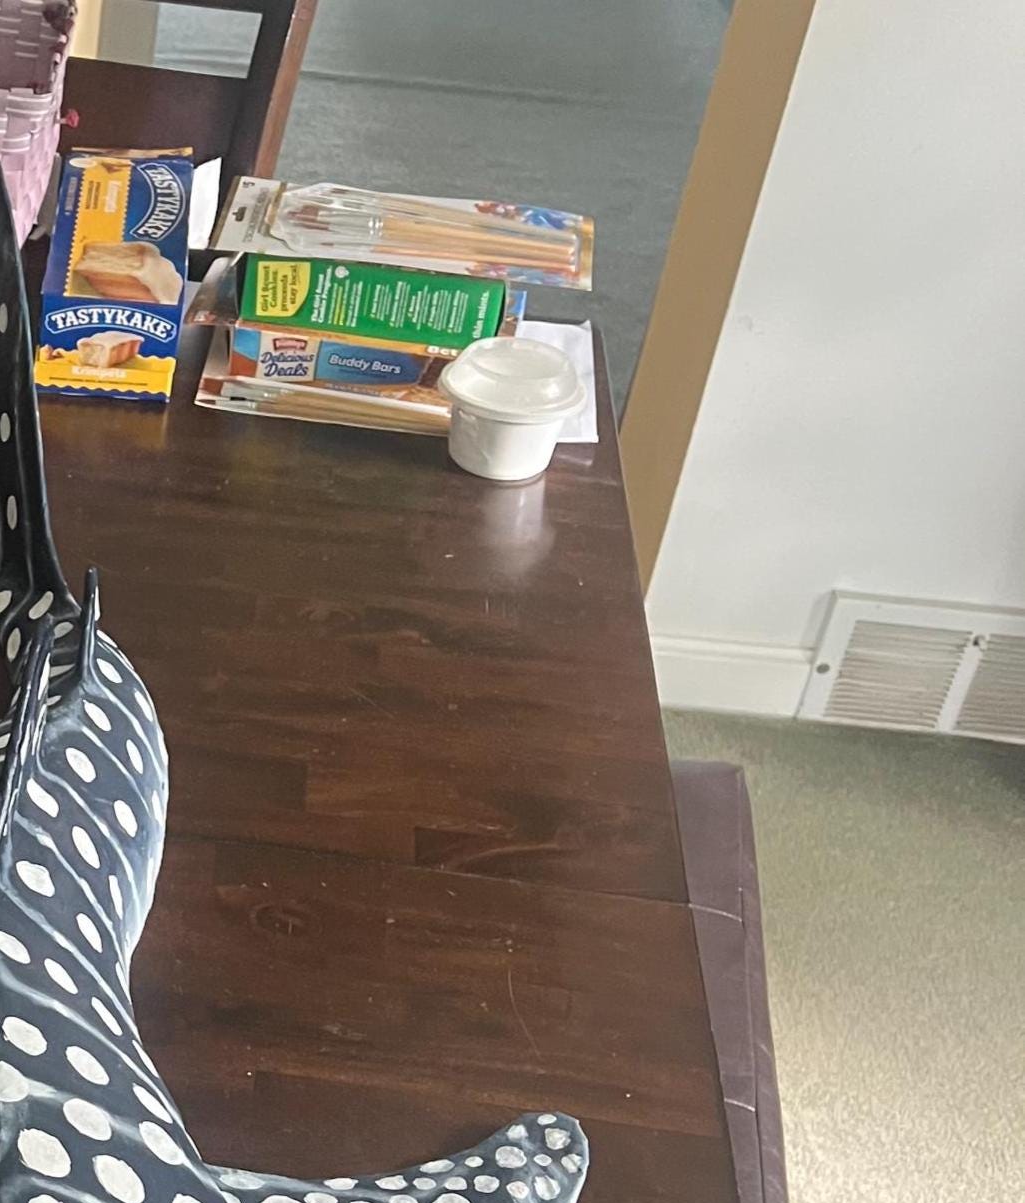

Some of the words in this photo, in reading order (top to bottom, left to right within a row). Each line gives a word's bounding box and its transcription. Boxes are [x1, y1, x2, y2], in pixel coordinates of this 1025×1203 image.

[136, 167, 181, 238] TASTYKAKE
[50, 308, 172, 339] TASTYKAKE
[260, 352, 315, 364] Delicious
[329, 353, 370, 371] Buddy
[371, 360, 401, 374] Bars
[263, 363, 309, 377] Deals
